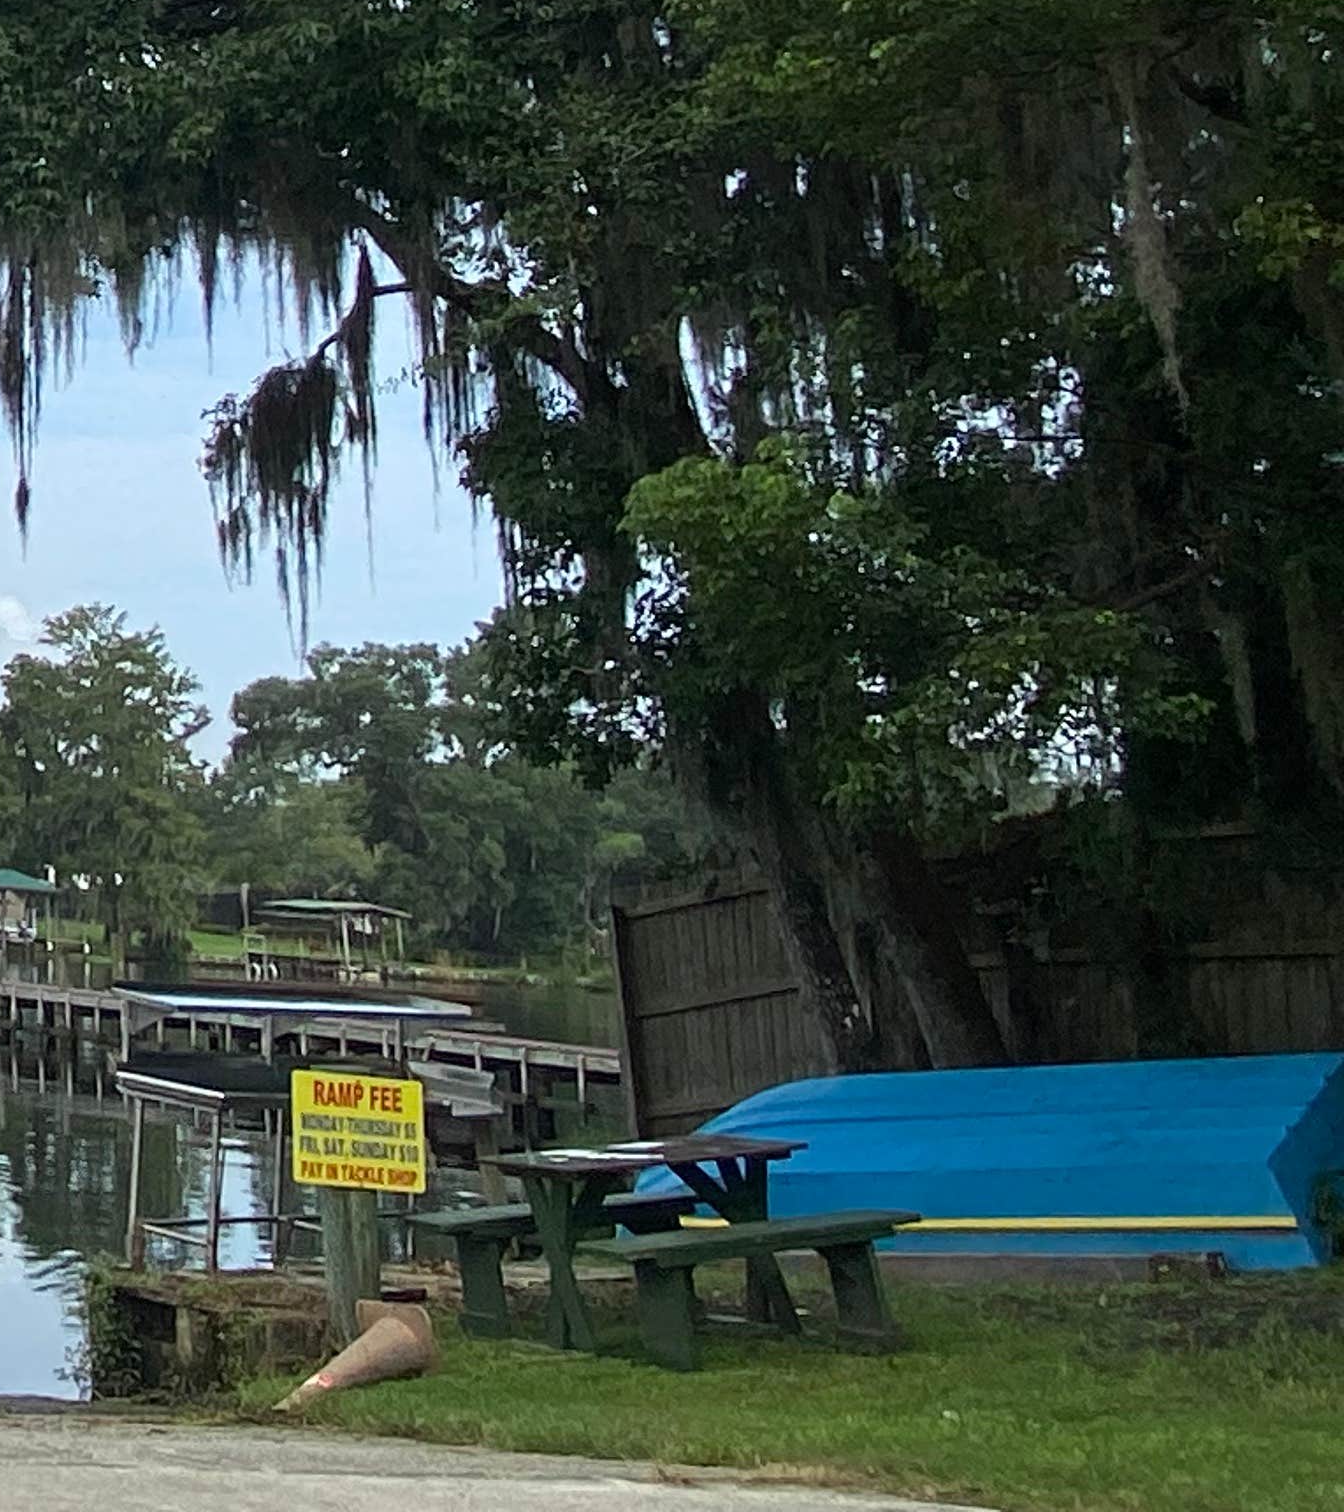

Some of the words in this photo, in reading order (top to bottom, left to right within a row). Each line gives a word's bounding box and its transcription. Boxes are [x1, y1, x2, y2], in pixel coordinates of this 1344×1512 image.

[313, 1080, 364, 1108] RAMP
[369, 1086, 403, 1113] FEE
[351, 1140, 395, 1160] SUNDAY
[301, 1160, 323, 1178] PAY
[326, 1163, 338, 1180] IN
[341, 1164, 385, 1185] TACKLE
[387, 1168, 417, 1186] SHOP
